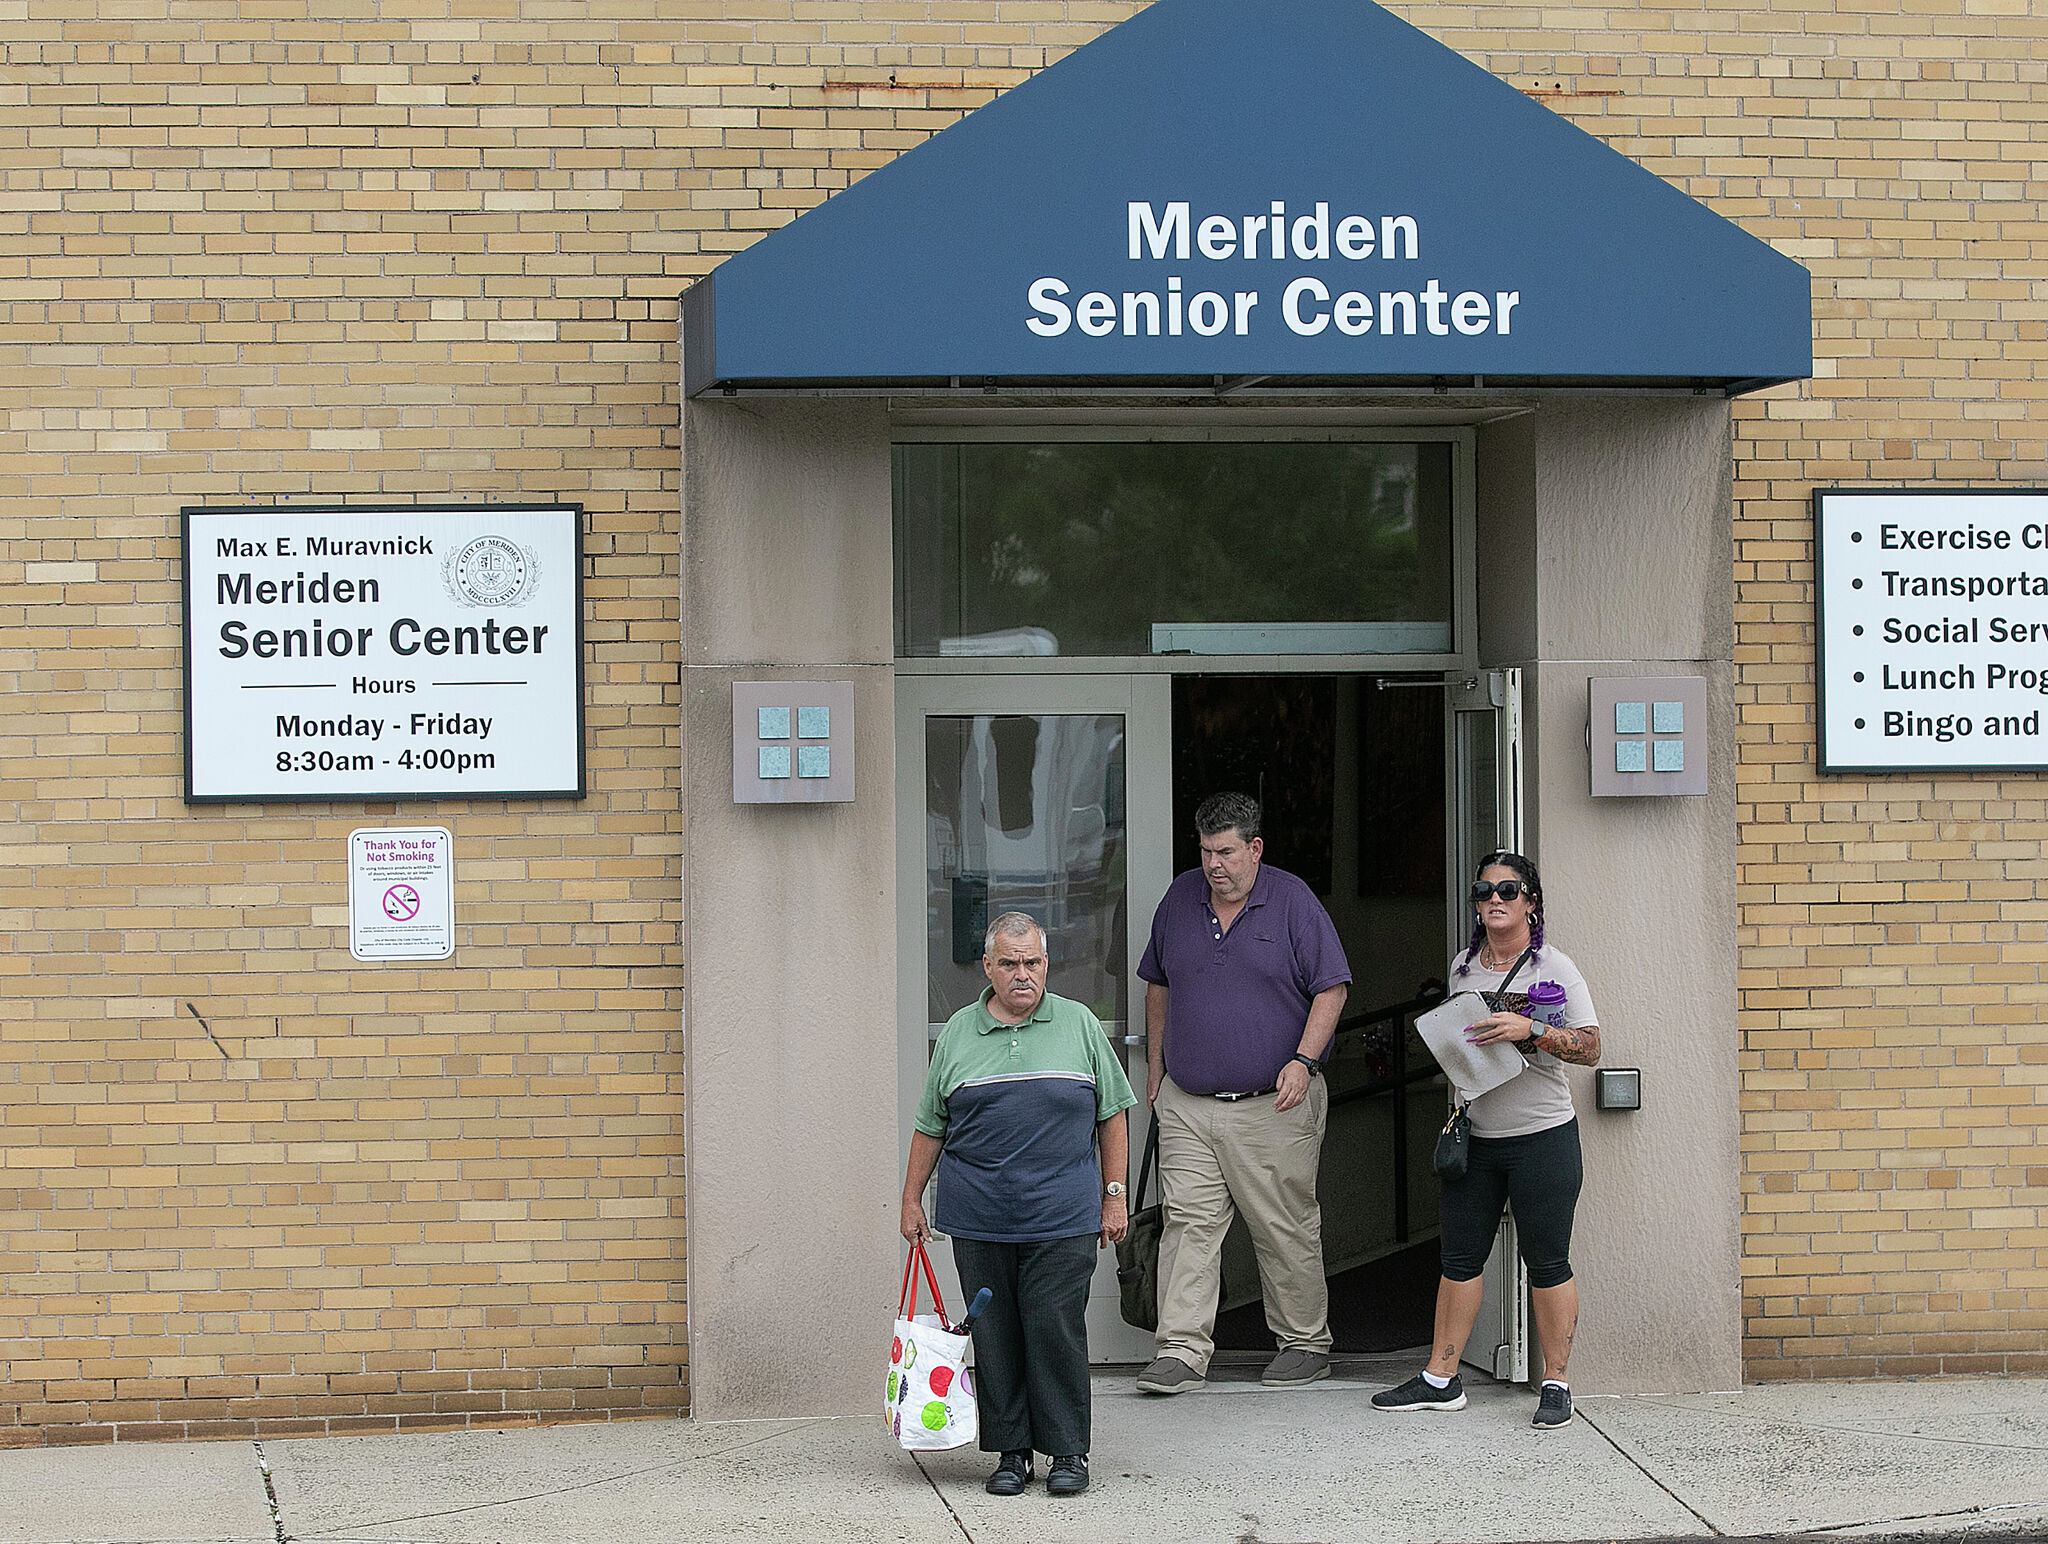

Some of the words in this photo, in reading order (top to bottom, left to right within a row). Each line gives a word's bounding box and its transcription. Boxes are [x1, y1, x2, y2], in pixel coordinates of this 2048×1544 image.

[1129, 201, 1418, 259] Meriden
[1026, 277, 1257, 336] Senior
[1283, 277, 1519, 335] Center
[216, 538, 268, 557] Max
[276, 538, 297, 556] E.
[306, 536, 434, 555] Muravnick
[1880, 524, 2011, 549] Exercise
[461, 546, 474, 564] CITY
[475, 540, 487, 549] OF
[488, 539, 521, 563] MERIDEN
[217, 572, 379, 604] Meriden
[466, 587, 516, 603] MDCCCLXVII
[1881, 572, 2048, 602] Transporta
[218, 619, 373, 658] Senior
[389, 618, 549, 655] Center
[1882, 618, 1978, 643] Social
[352, 677, 416, 693] Hours
[1883, 664, 1975, 689] Lunch
[276, 715, 385, 740] Monday
[410, 713, 493, 739] Friday
[1883, 711, 1973, 742] Bingo
[1983, 711, 2039, 735] and
[276, 751, 374, 771] 8:30am
[397, 749, 495, 773] 4:00pm
[363, 840, 397, 849] Thank
[398, 841, 418, 849] You
[421, 840, 437, 848] for
[366, 853, 387, 861] Not
[388, 851, 435, 862] Smoking
[1548, 1009, 1564, 1021] FAT
